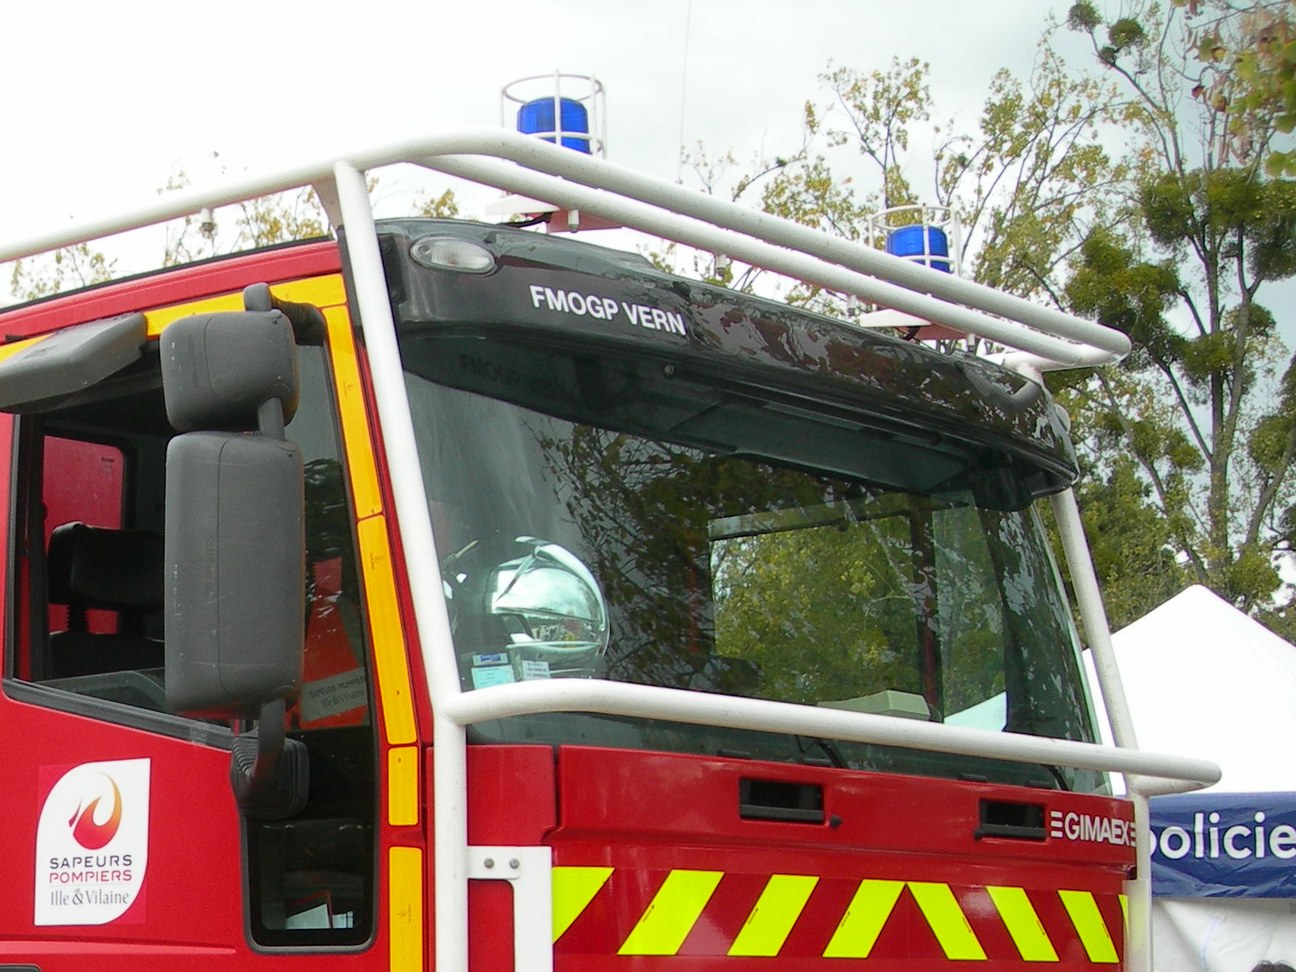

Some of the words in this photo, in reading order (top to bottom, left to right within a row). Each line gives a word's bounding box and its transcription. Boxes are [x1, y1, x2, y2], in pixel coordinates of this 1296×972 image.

[529, 284, 618, 320] FMOGP
[621, 301, 686, 336] VERN
[1150, 811, 1296, 860] olicie
[49, 854, 133, 870] SAPEURS
[49, 869, 133, 884] POMPIERS
[50, 890, 69, 906] Ille
[72, 887, 84, 906] &
[85, 888, 130, 905] Vilaine
